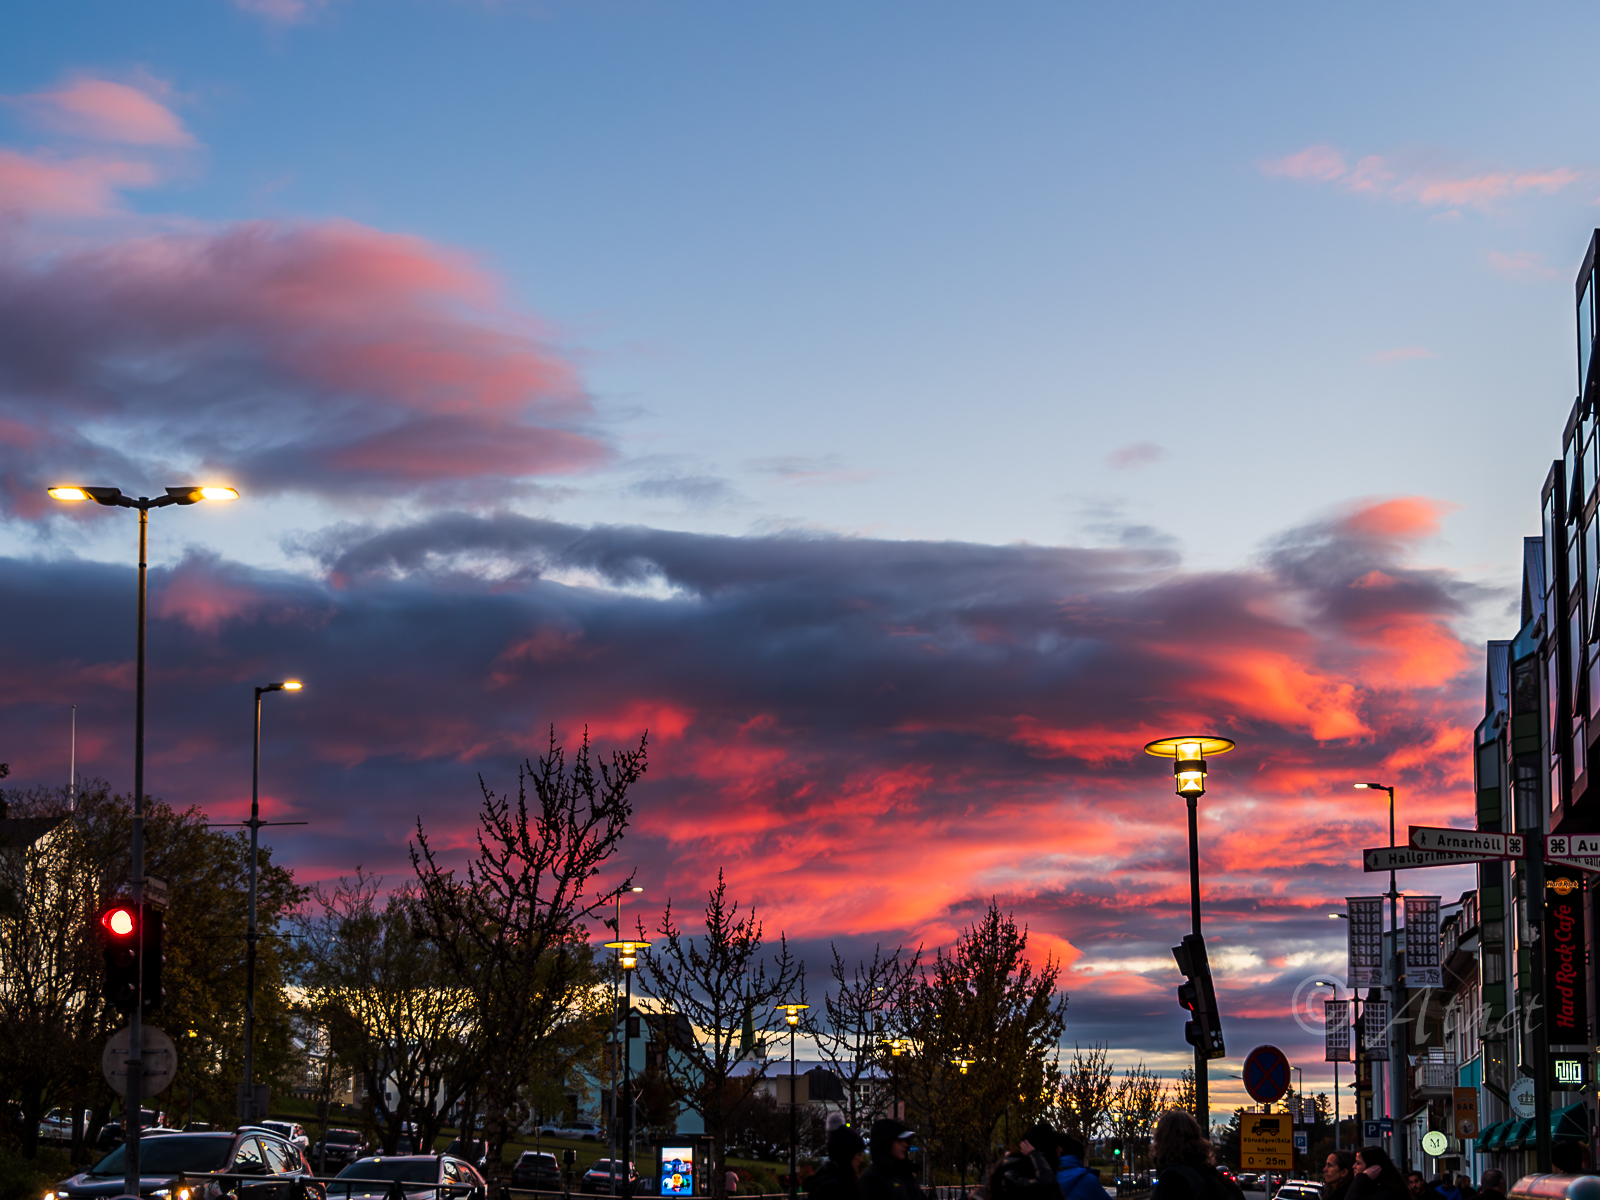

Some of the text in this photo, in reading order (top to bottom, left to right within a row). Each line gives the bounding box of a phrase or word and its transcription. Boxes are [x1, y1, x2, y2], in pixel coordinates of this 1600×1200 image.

[1437, 833, 1501, 851] Arnarhóll
[1553, 904, 1576, 942] Cafe
[1554, 944, 1578, 984] Rock
[1556, 985, 1575, 1028] Hard
[1456, 1103, 1475, 1111] BAR
[1368, 1124, 1377, 1136] P
[1243, 1136, 1291, 1144] Vöruafgreiðsla
[1248, 1157, 1254, 1165] 0
[1265, 1157, 1286, 1165] 25m
